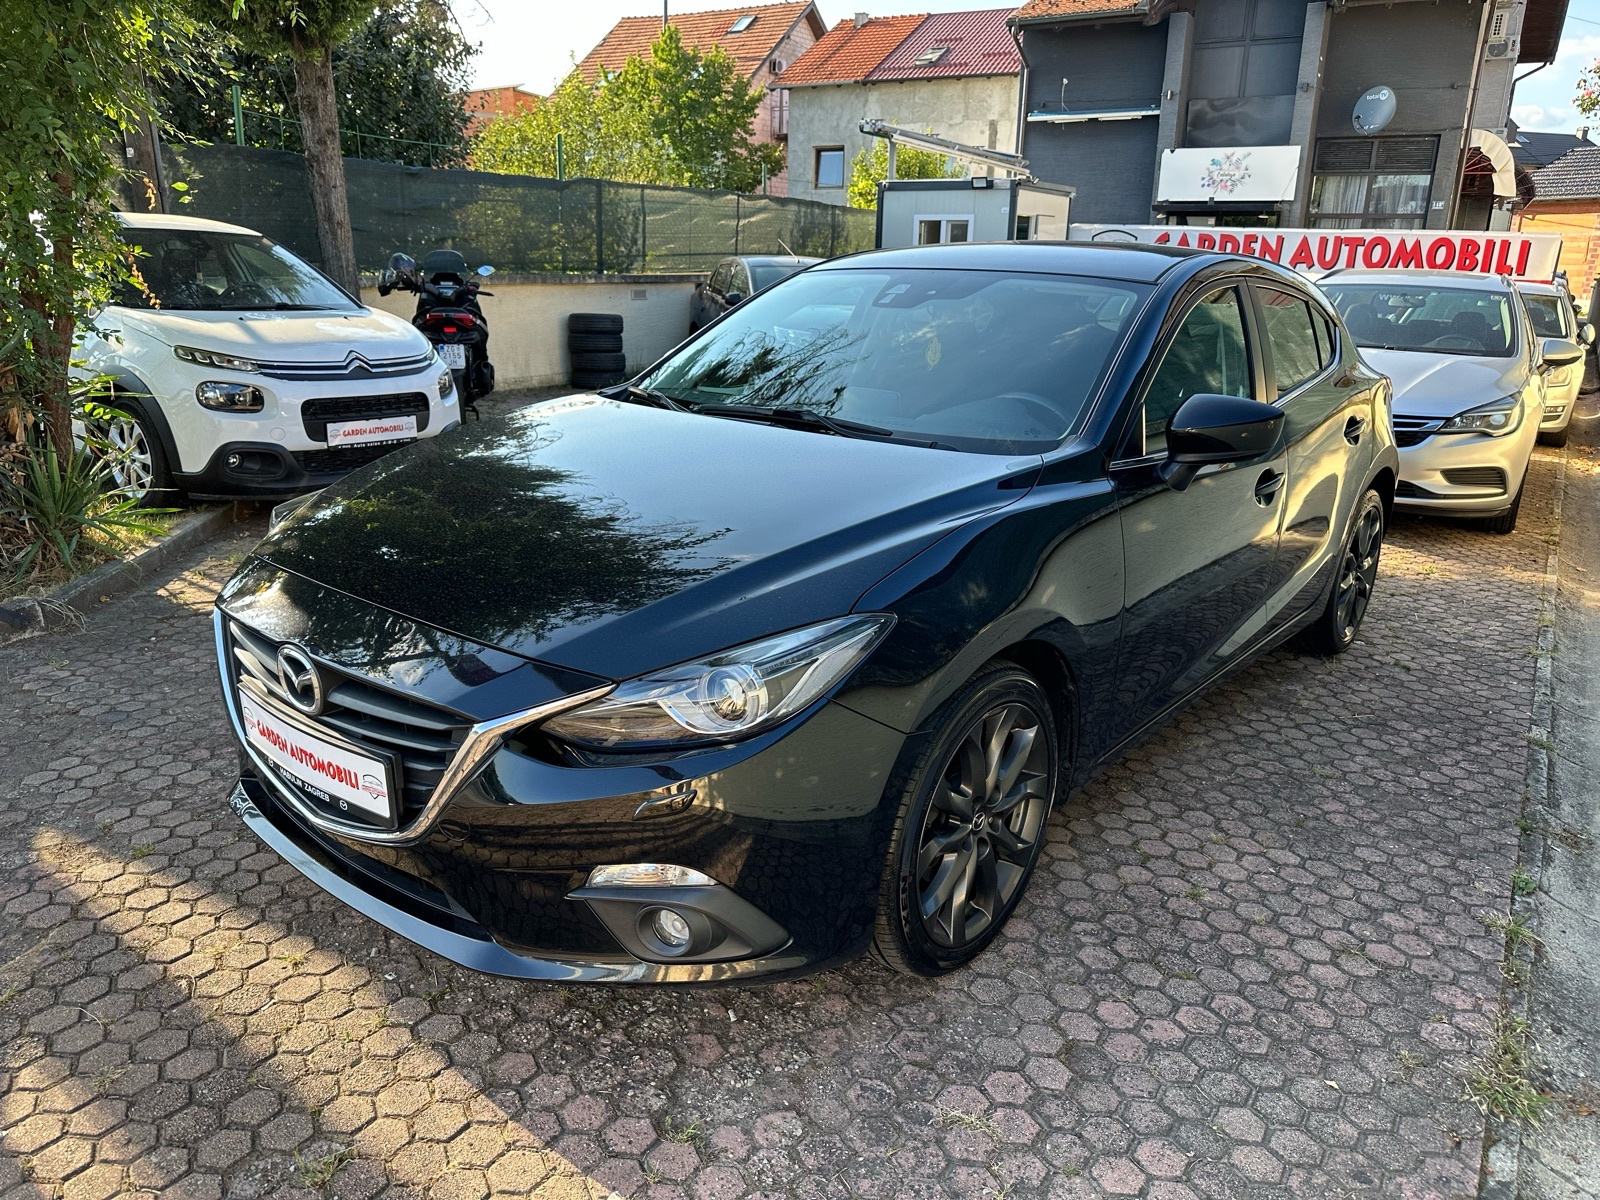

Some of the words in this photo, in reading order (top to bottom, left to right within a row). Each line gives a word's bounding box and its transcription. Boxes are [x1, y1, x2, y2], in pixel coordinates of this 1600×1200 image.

[1289, 234, 1532, 277] AUTOMOBILI
[443, 352, 462, 360] 2155
[446, 345, 455, 353] ZG
[342, 427, 368, 438] GARDEN
[368, 424, 404, 435] AUTOMOBILI
[256, 719, 290, 756] GARDEN
[290, 743, 360, 790] AUTOMOBILI
[304, 782, 330, 802] ZAGREB
